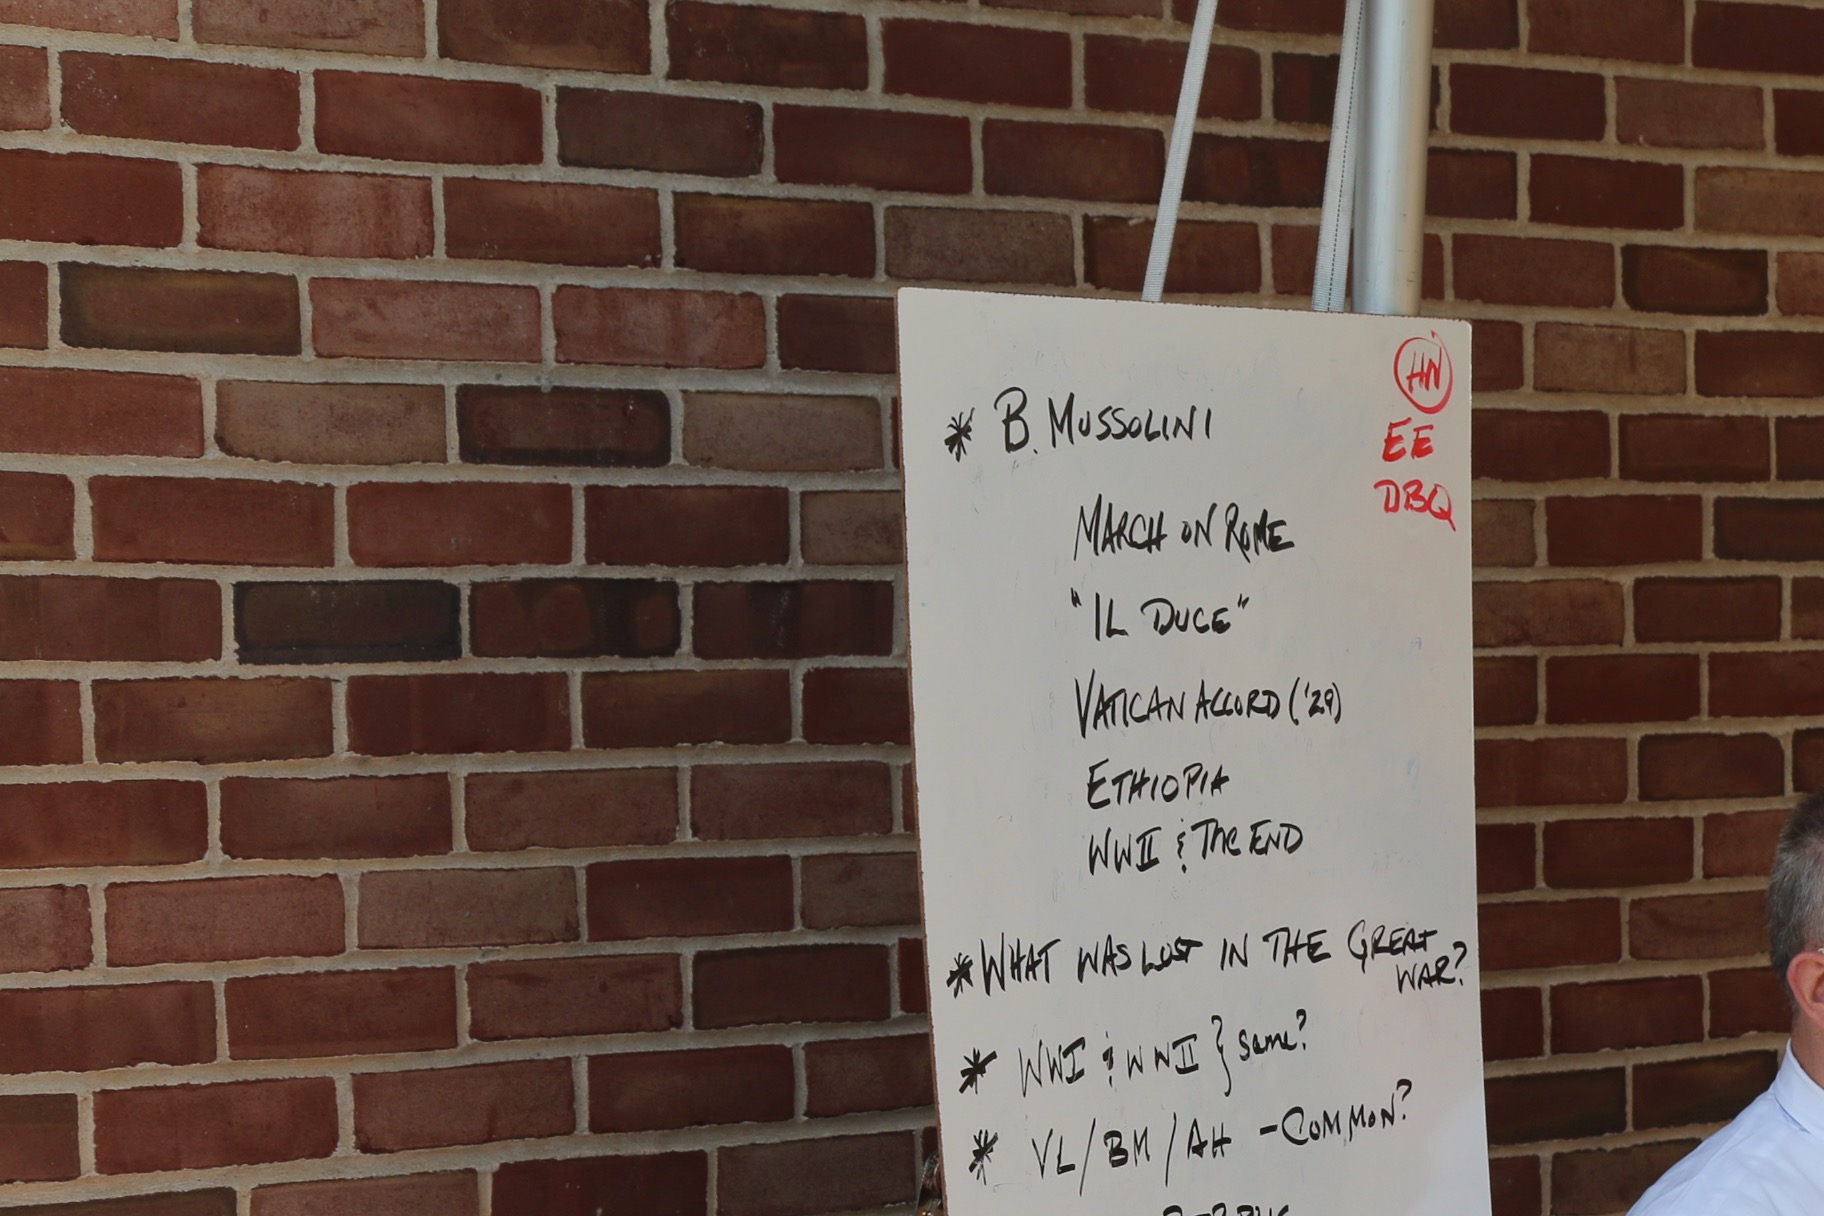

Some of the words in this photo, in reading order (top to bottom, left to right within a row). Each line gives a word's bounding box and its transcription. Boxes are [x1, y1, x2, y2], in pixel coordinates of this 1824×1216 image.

[1047, 391, 1212, 449] MUSSOLINI
[1382, 417, 1434, 462] EE
[1073, 493, 1168, 562] MARCH
[1180, 502, 1218, 548] ON
[1224, 502, 1295, 563] ROME
[1373, 479, 1456, 531] DBQ
[1074, 668, 1186, 739] VATICAN
[1194, 679, 1281, 724] ACCORD
[1086, 758, 1230, 810] ETHIOPIA
[1088, 826, 1162, 876] WWII
[1248, 819, 1304, 856] END
[979, 932, 1062, 997] WHAT
[1077, 934, 1133, 984] WAS
[1220, 933, 1249, 971] IN
[1262, 927, 1332, 968] THE
[1347, 919, 1438, 974] GREAT
[1396, 941, 1468, 994] WAR?
[1018, 1036, 1086, 1099] WWI
